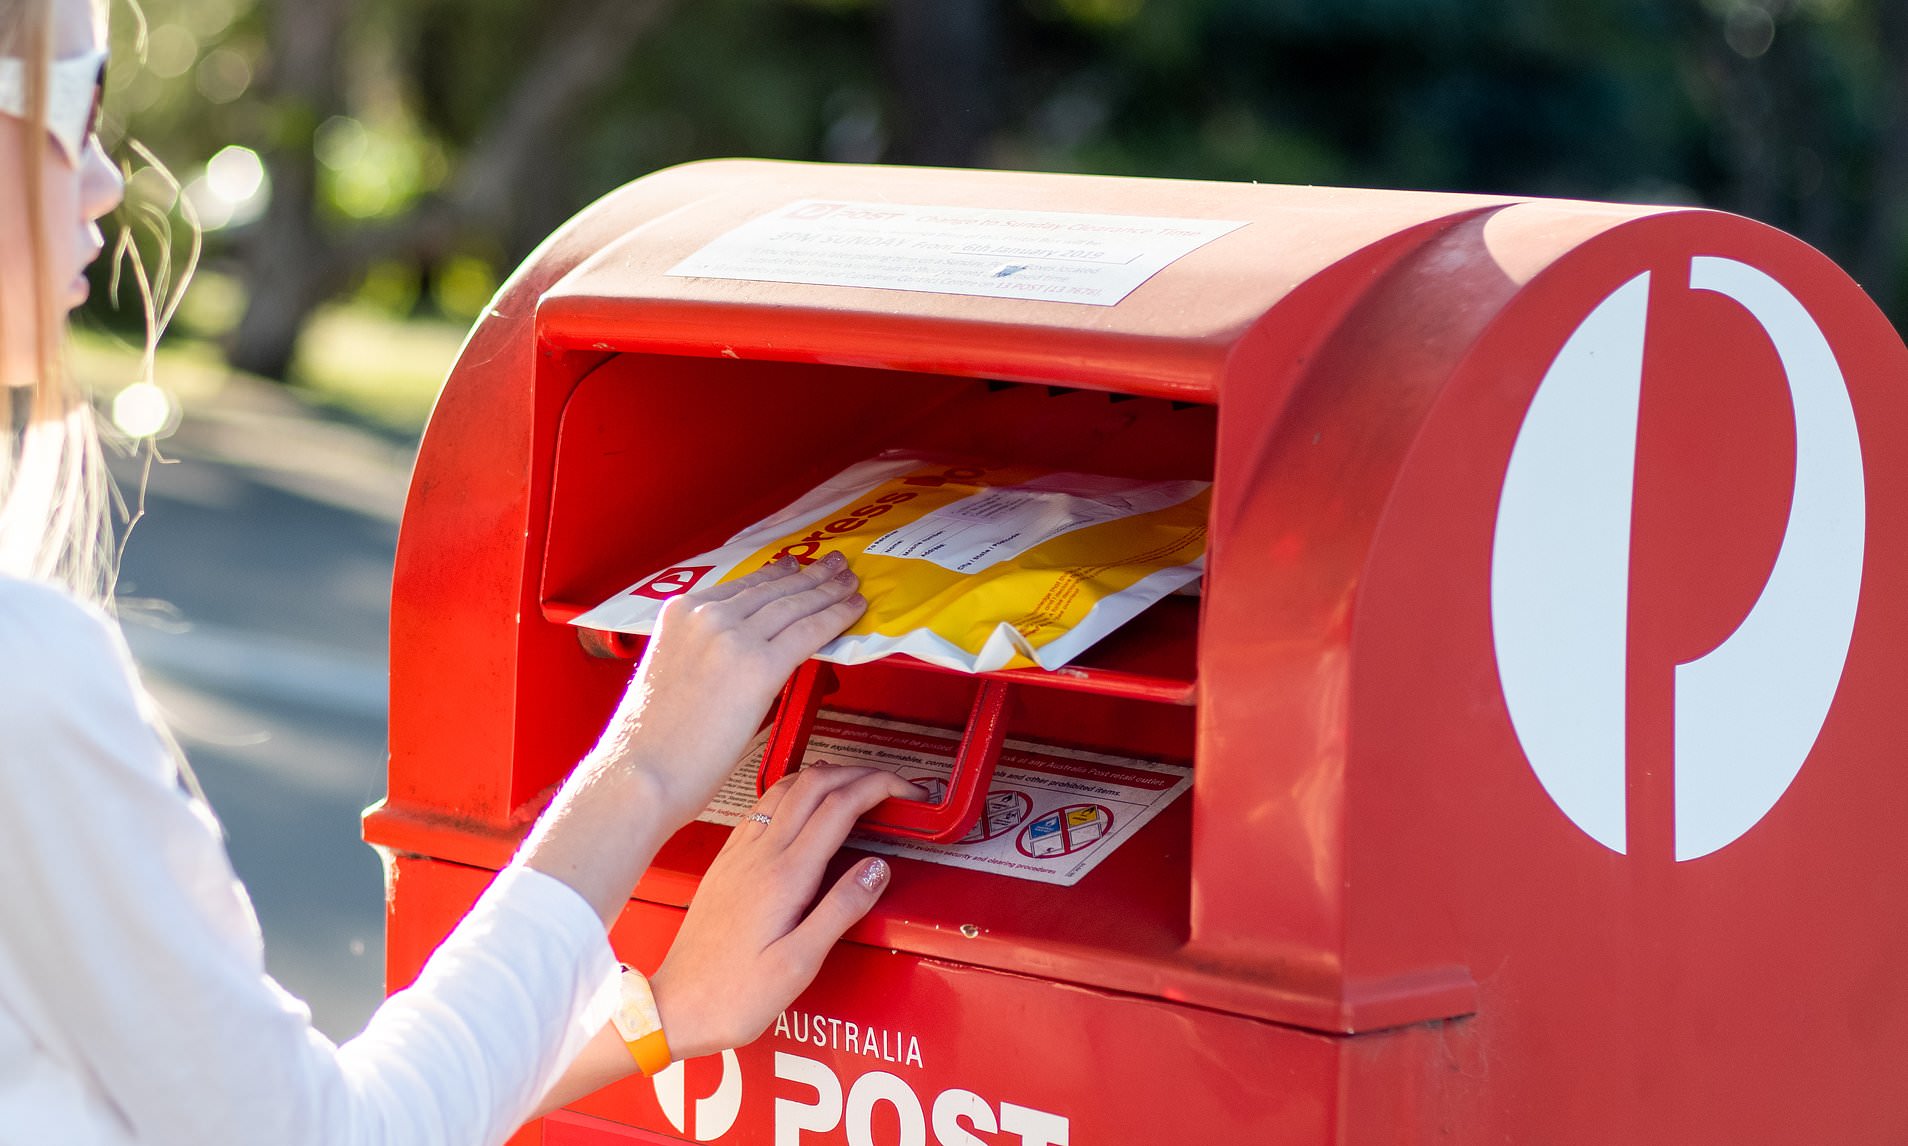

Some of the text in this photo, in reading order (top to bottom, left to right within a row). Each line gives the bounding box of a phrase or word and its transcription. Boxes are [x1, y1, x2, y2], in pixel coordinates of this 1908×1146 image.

[1005, 220, 1062, 231] Sunday
[1067, 223, 1153, 234] Clearance
[1158, 228, 1202, 237] Time
[825, 234, 911, 247] SUNDAY
[961, 242, 993, 252] 6th
[992, 244, 1059, 257] January
[1062, 248, 1106, 258] 2019
[1010, 282, 1042, 291] POST
[763, 491, 919, 567] press
[869, 733, 894, 743] must
[919, 742, 954, 753] posted
[1028, 759, 1048, 768] any
[1047, 761, 1087, 773] Australia
[1087, 767, 1110, 777] Post
[1110, 772, 1136, 782] retail
[1007, 773, 1026, 781] and
[1025, 775, 1050, 785] other
[1048, 779, 1096, 792] prohibited
[914, 845, 945, 854] aviation
[943, 850, 972, 861] security
[987, 857, 1016, 869] clearing
[1015, 863, 1057, 875] procedures
[774, 1010, 924, 1069] AUSTRALIA
